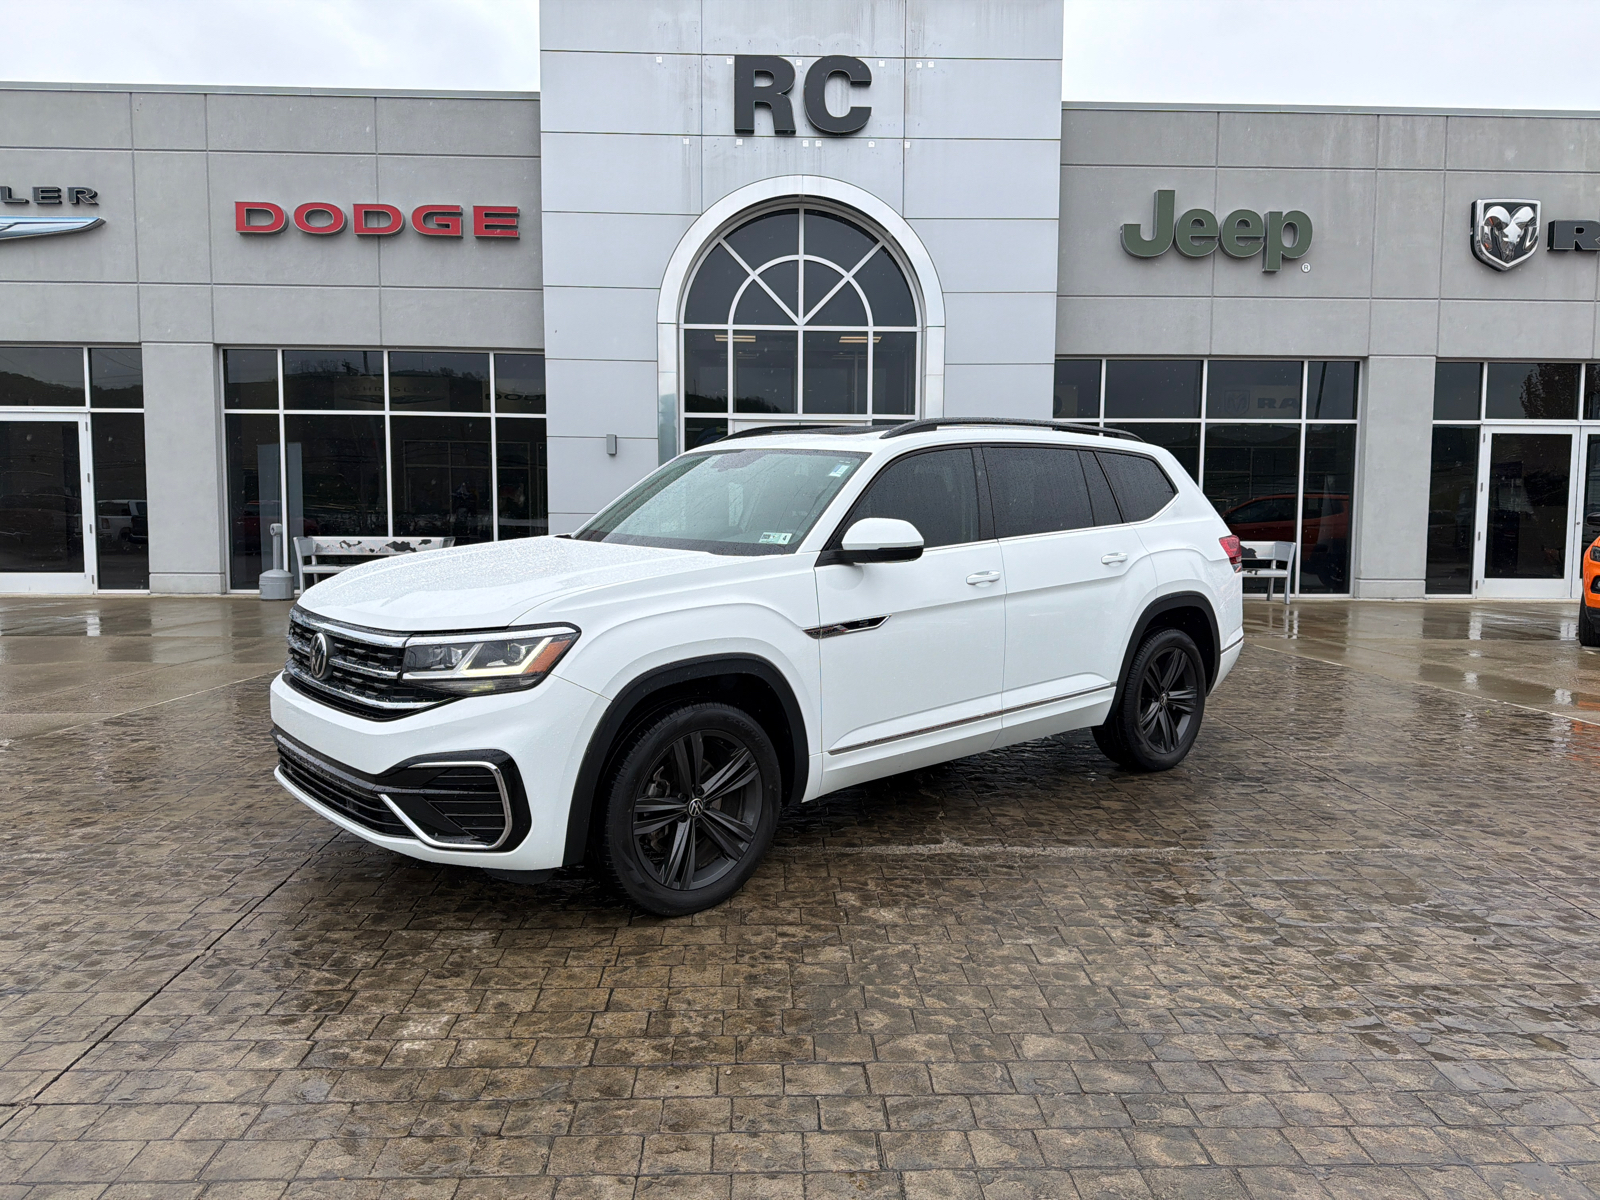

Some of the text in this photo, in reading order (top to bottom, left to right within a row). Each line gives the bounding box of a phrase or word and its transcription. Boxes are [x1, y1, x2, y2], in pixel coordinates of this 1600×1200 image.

[734, 55, 872, 135] RC
[235, 201, 520, 239] DODGE
[1119, 189, 1313, 273] Jeep
